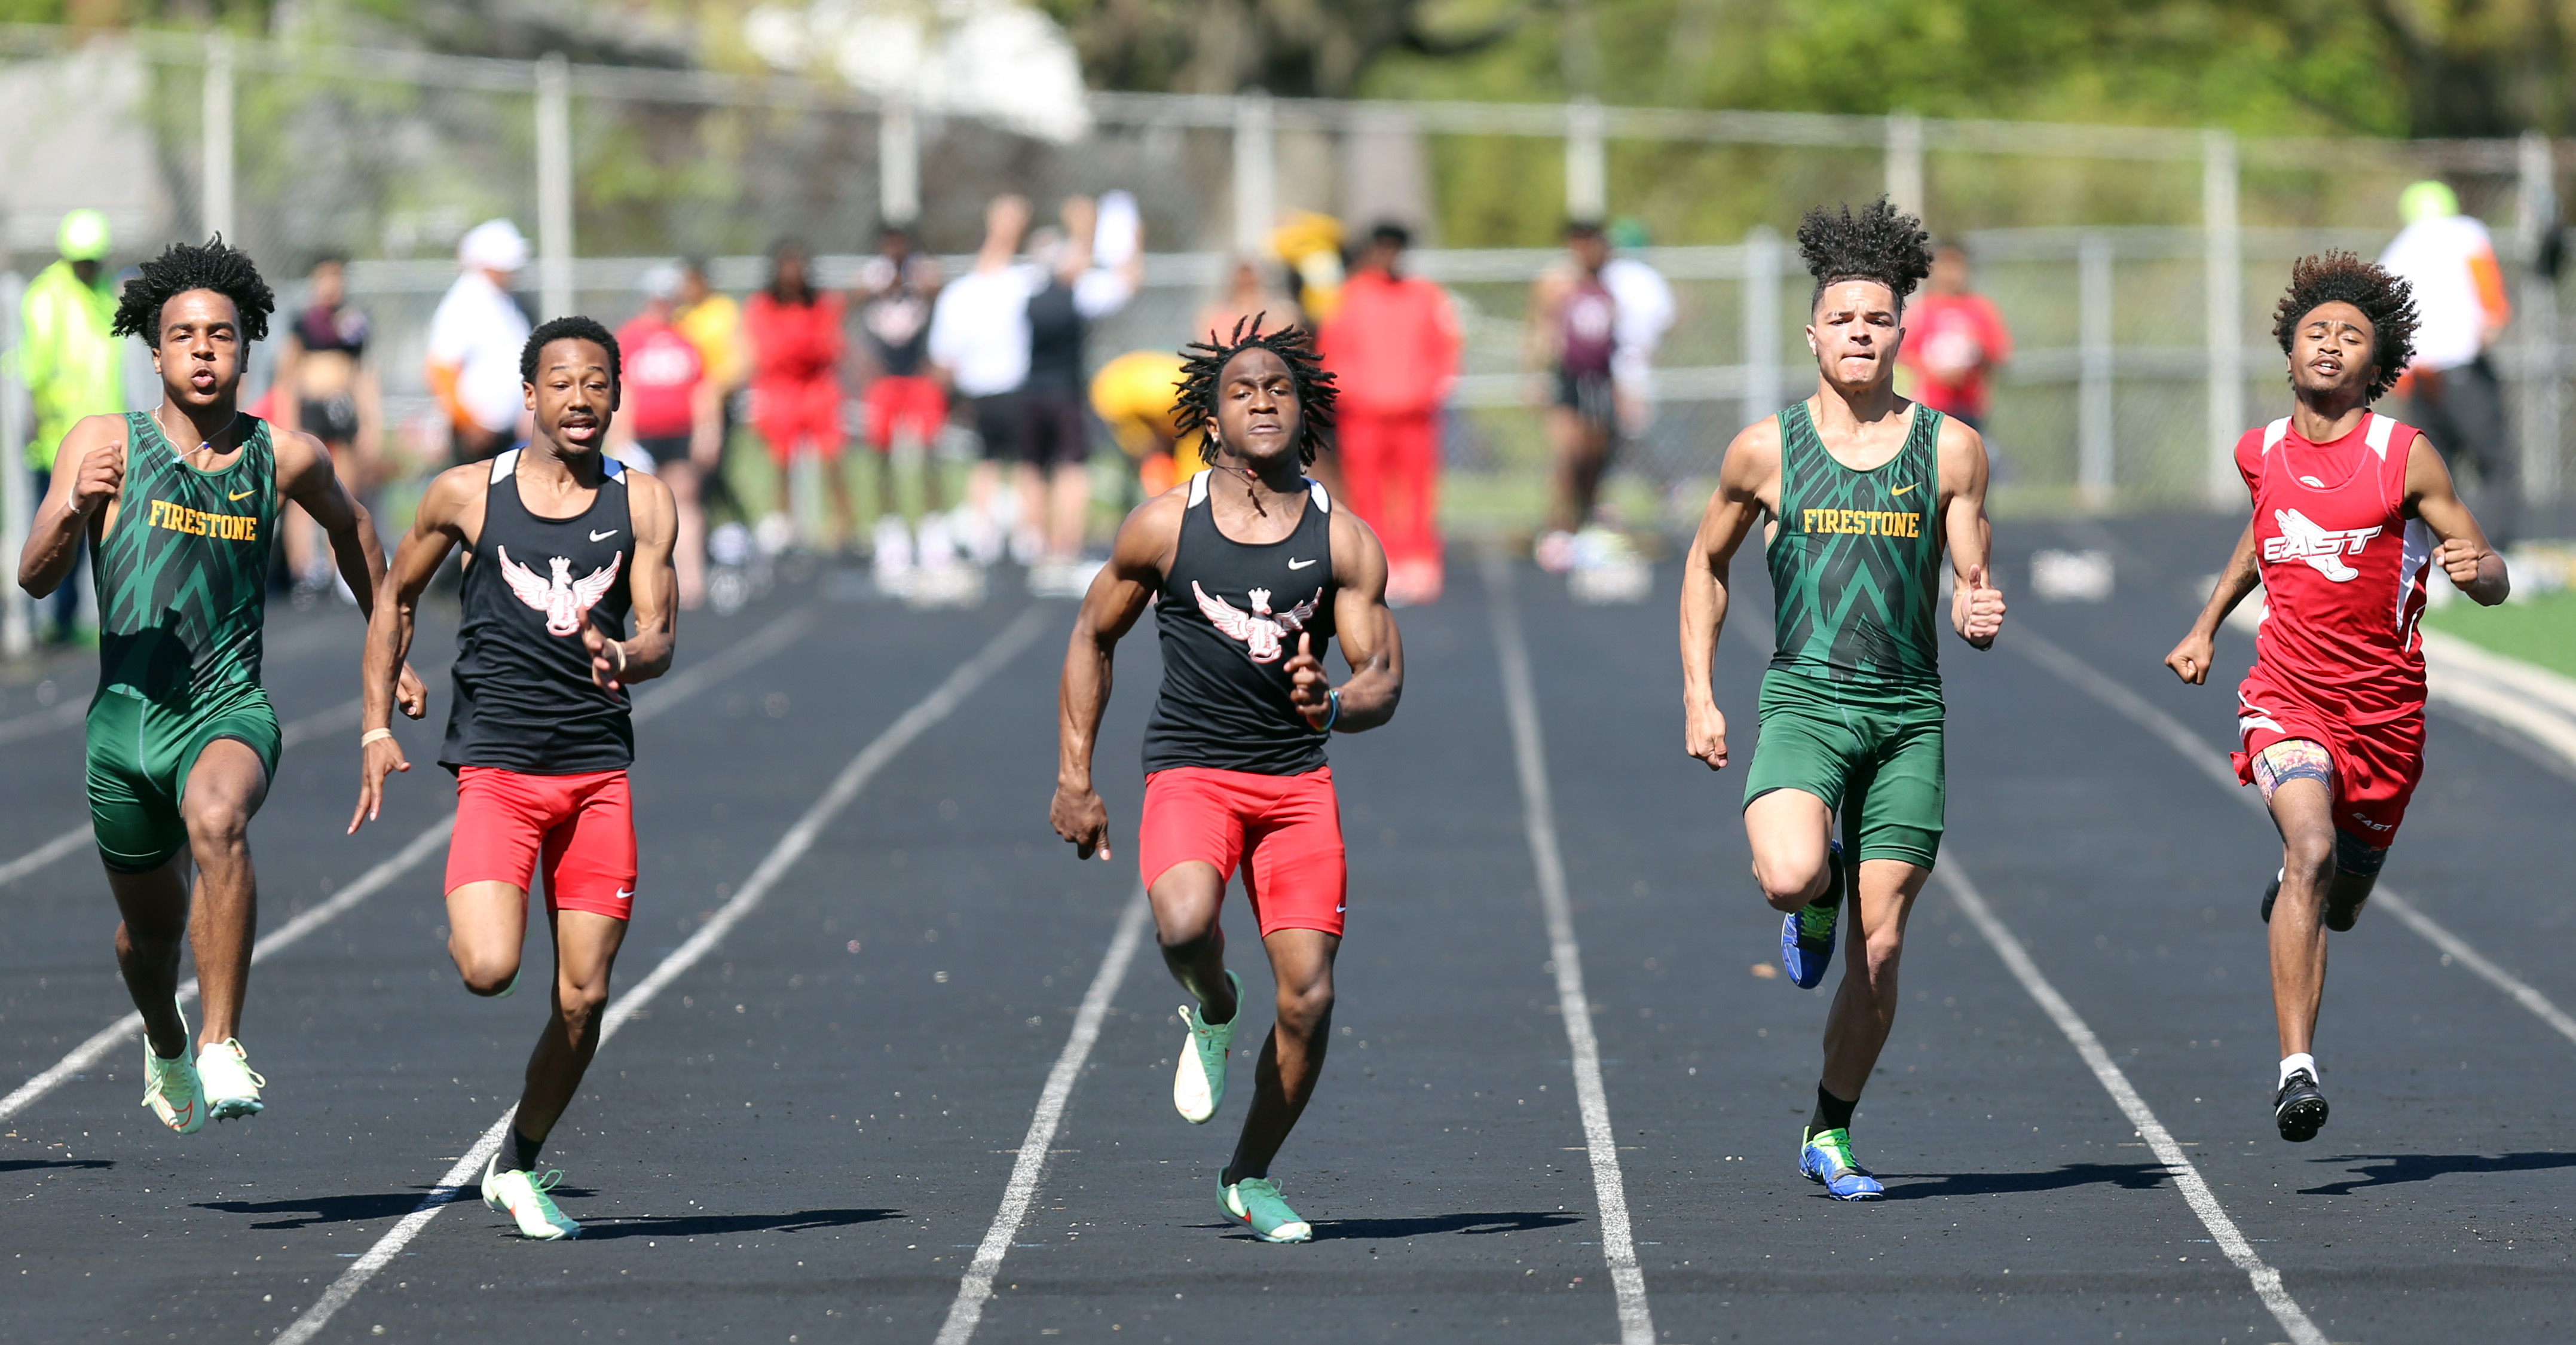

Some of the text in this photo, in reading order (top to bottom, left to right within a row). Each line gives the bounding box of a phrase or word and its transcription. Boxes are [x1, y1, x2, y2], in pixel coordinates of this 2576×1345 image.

[148, 499, 257, 541] FIRESTONE
[1803, 509, 1920, 537] FIRESTONE
[2263, 525, 2383, 563] EAST
[2352, 812, 2393, 832] EAST
